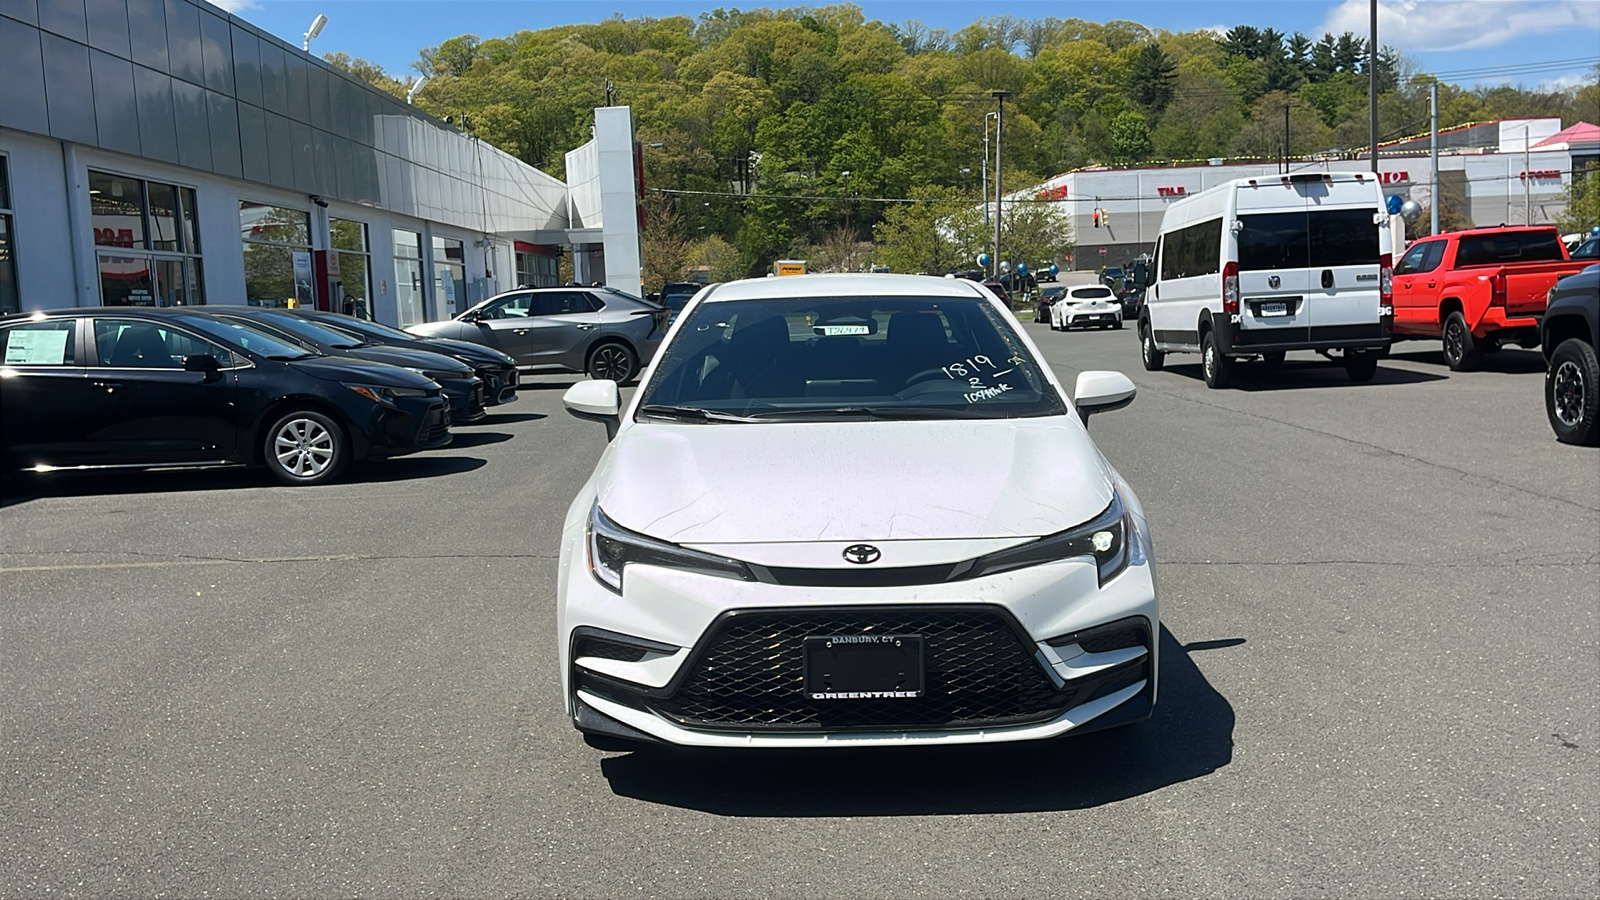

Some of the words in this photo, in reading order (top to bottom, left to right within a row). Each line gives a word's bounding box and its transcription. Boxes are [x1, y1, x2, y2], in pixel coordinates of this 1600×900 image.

[1157, 187, 1185, 197] TILE
[941, 355, 997, 380] 1819
[832, 636, 880, 644] DANBURY,
[812, 691, 918, 700] GREENTREE
